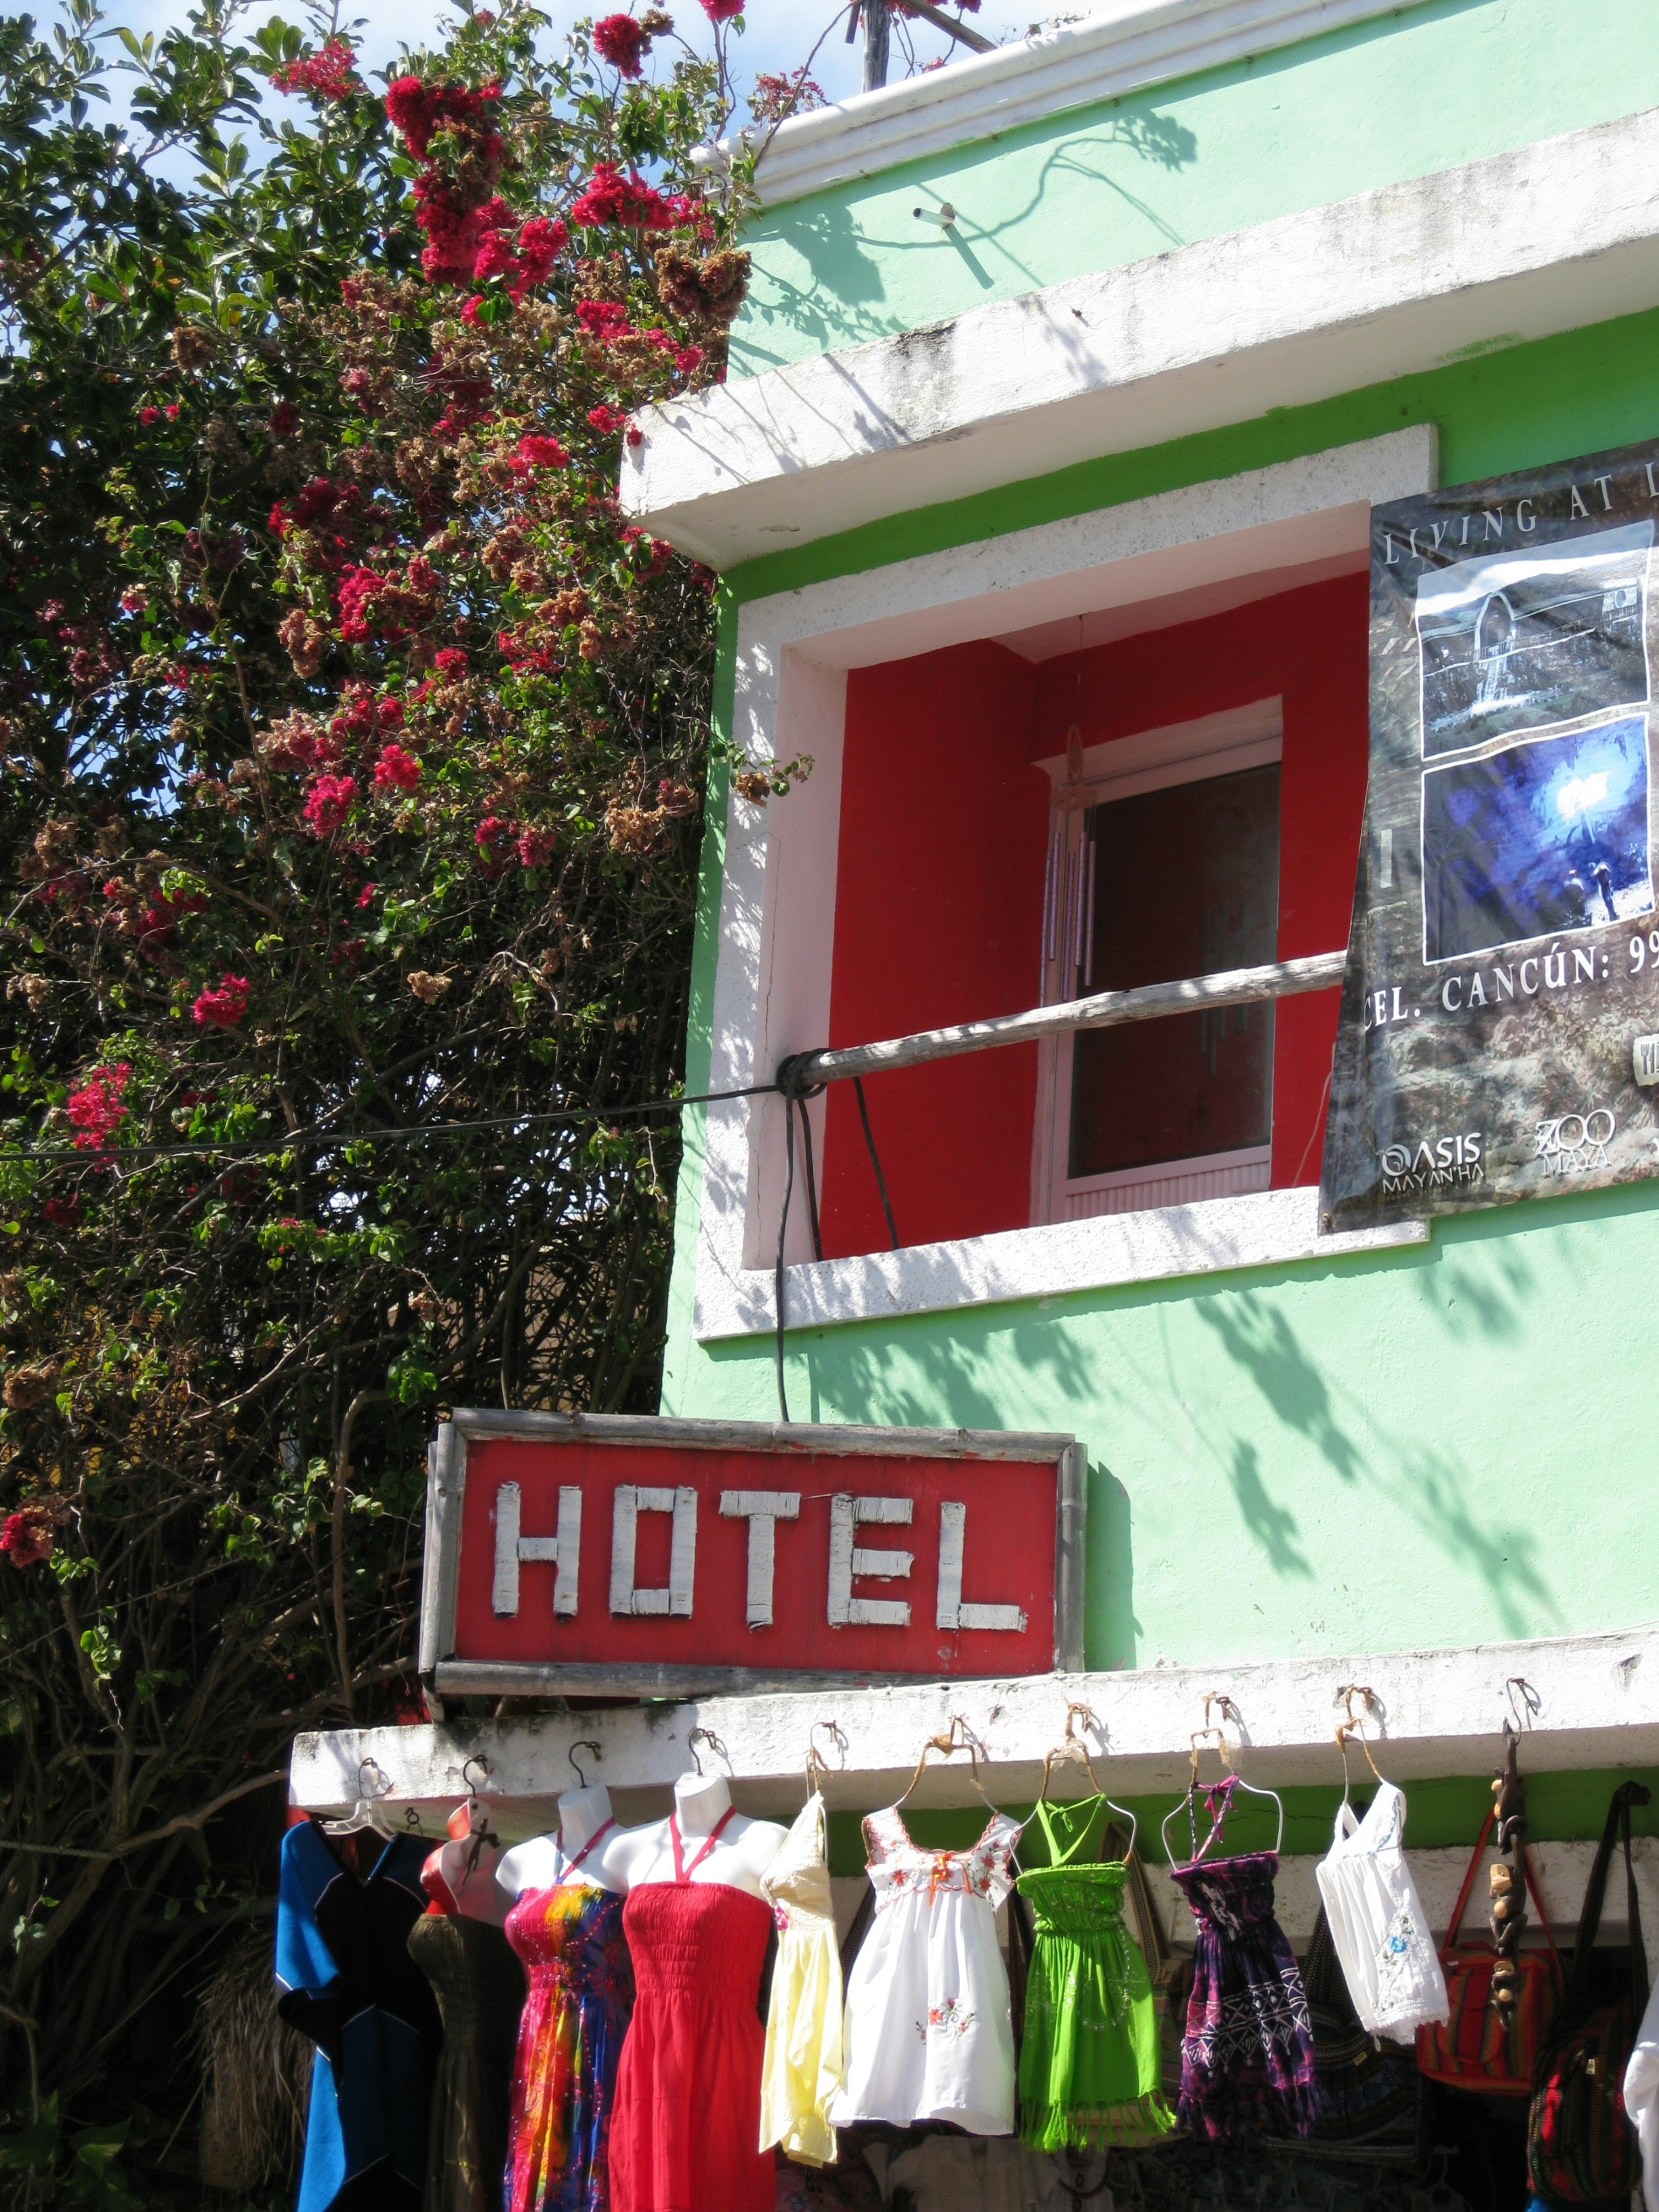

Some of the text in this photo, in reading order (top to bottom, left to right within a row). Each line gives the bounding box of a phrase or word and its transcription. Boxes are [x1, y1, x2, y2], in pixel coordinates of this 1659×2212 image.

[1384, 499, 1536, 565] LIVING
[1570, 474, 1614, 520] AT
[1441, 942, 1609, 1012] CANCÚN:
[1382, 1132, 1481, 1176] OASIS
[1532, 1109, 1616, 1155] ZOO
[1382, 1163, 1484, 1194] MAYAN'HA
[1542, 1143, 1612, 1176] MAYA
[491, 1481, 1028, 1633] HOTEL
